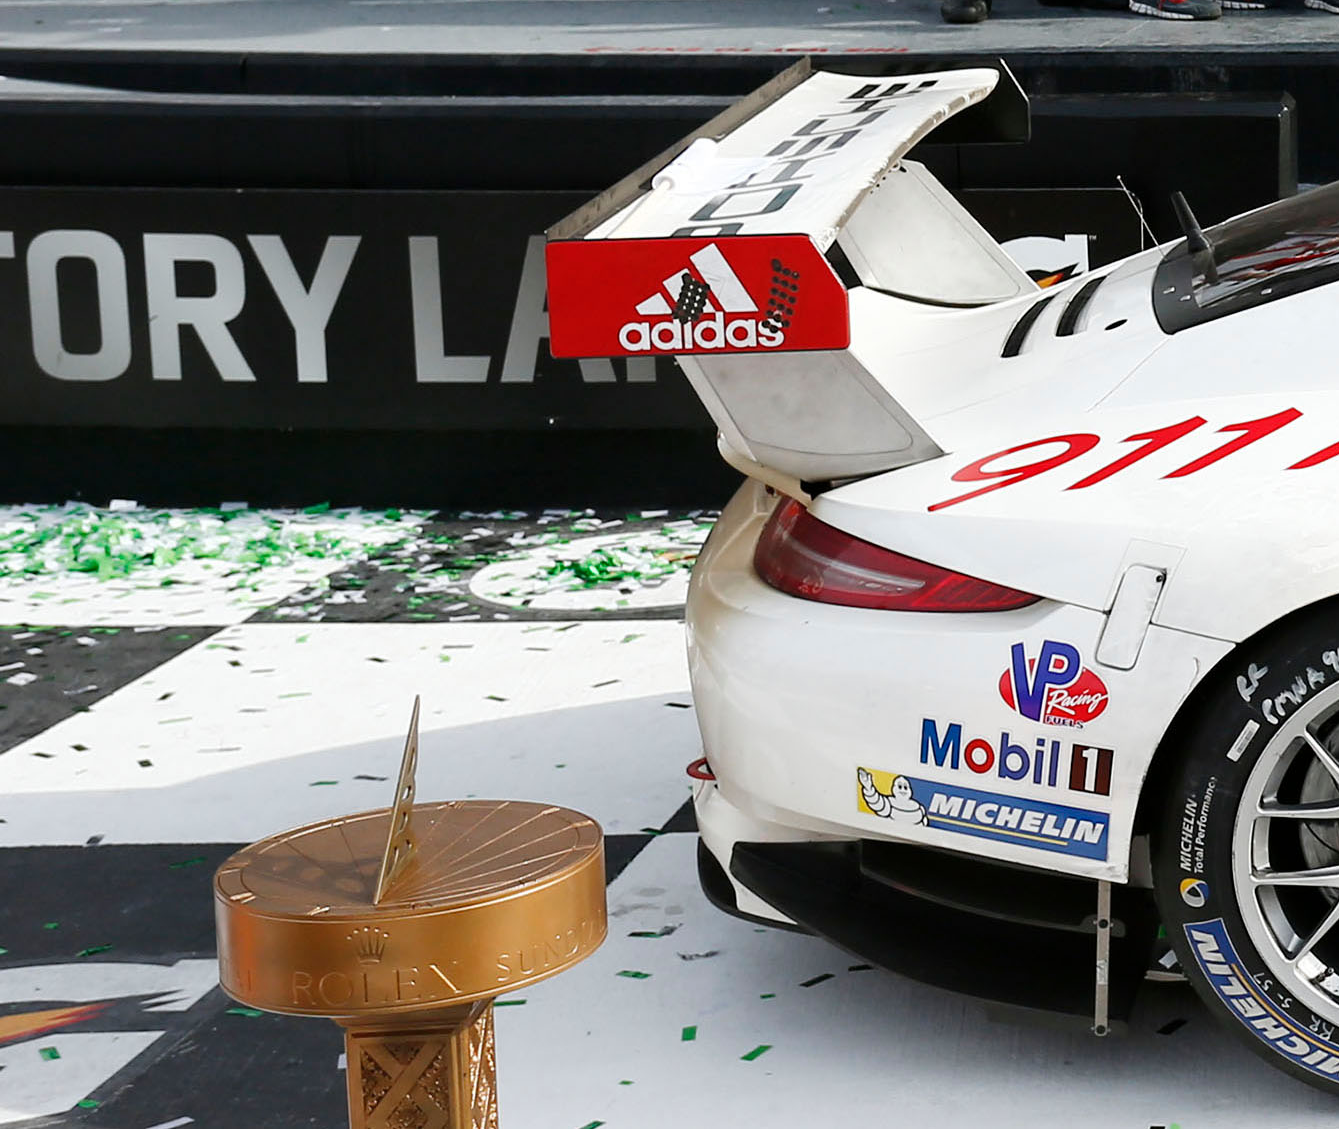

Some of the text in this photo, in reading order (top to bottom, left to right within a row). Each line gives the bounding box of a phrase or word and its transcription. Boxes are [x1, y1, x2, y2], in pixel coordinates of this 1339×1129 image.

[618, 311, 785, 353] adidas
[926, 405, 1304, 513] 911
[1010, 640, 1082, 723] VP
[1047, 688, 1110, 717] Racing
[1045, 715, 1084, 729] FUELS
[919, 718, 1061, 787] Mobil
[928, 792, 1105, 845] MICHELIN
[1179, 798, 1198, 872] MICHELIN
[1194, 848, 1205, 874] Total
[293, 962, 464, 1007] ROLEX
